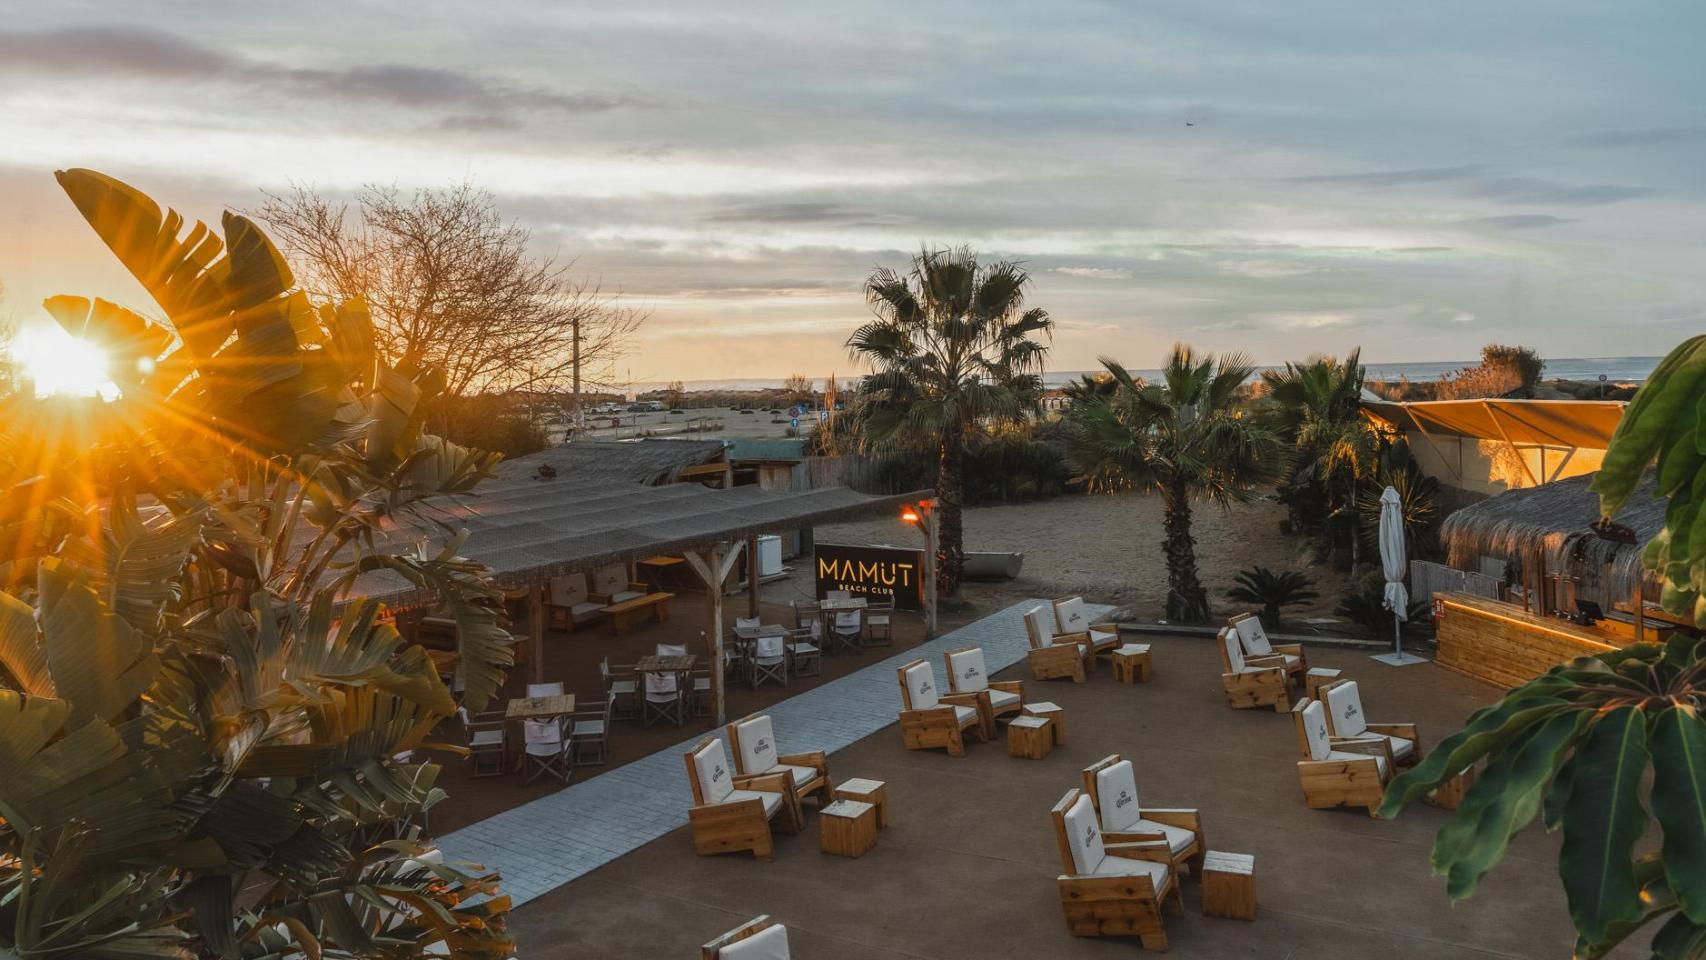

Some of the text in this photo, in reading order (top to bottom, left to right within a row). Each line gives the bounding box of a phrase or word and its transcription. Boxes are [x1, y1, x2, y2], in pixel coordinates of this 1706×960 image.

[820, 558, 913, 586] MAMUT
[839, 584, 894, 595] BEACH CLUB
